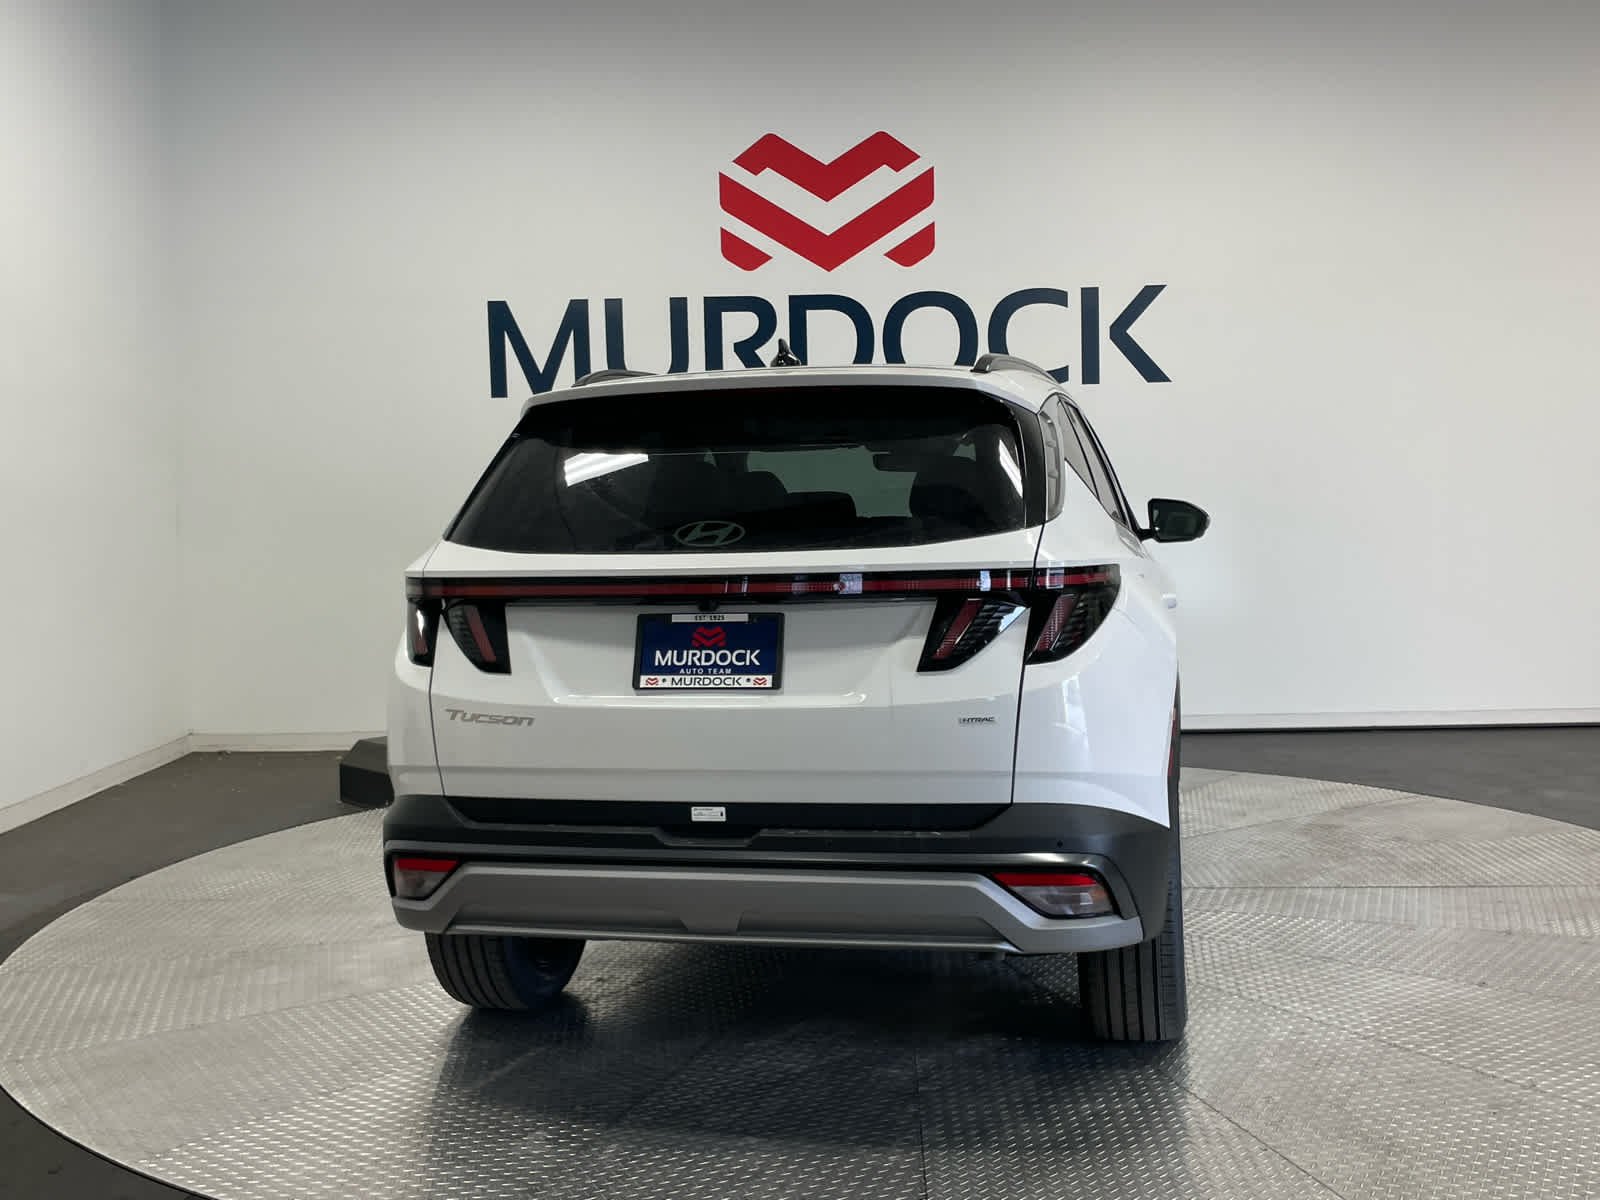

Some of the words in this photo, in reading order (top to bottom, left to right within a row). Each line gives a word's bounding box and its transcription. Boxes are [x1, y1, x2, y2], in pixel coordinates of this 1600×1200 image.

[487, 284, 1172, 398] MURDOCK
[654, 649, 761, 666] MURDOCK
[671, 676, 742, 686] MURDOCK
